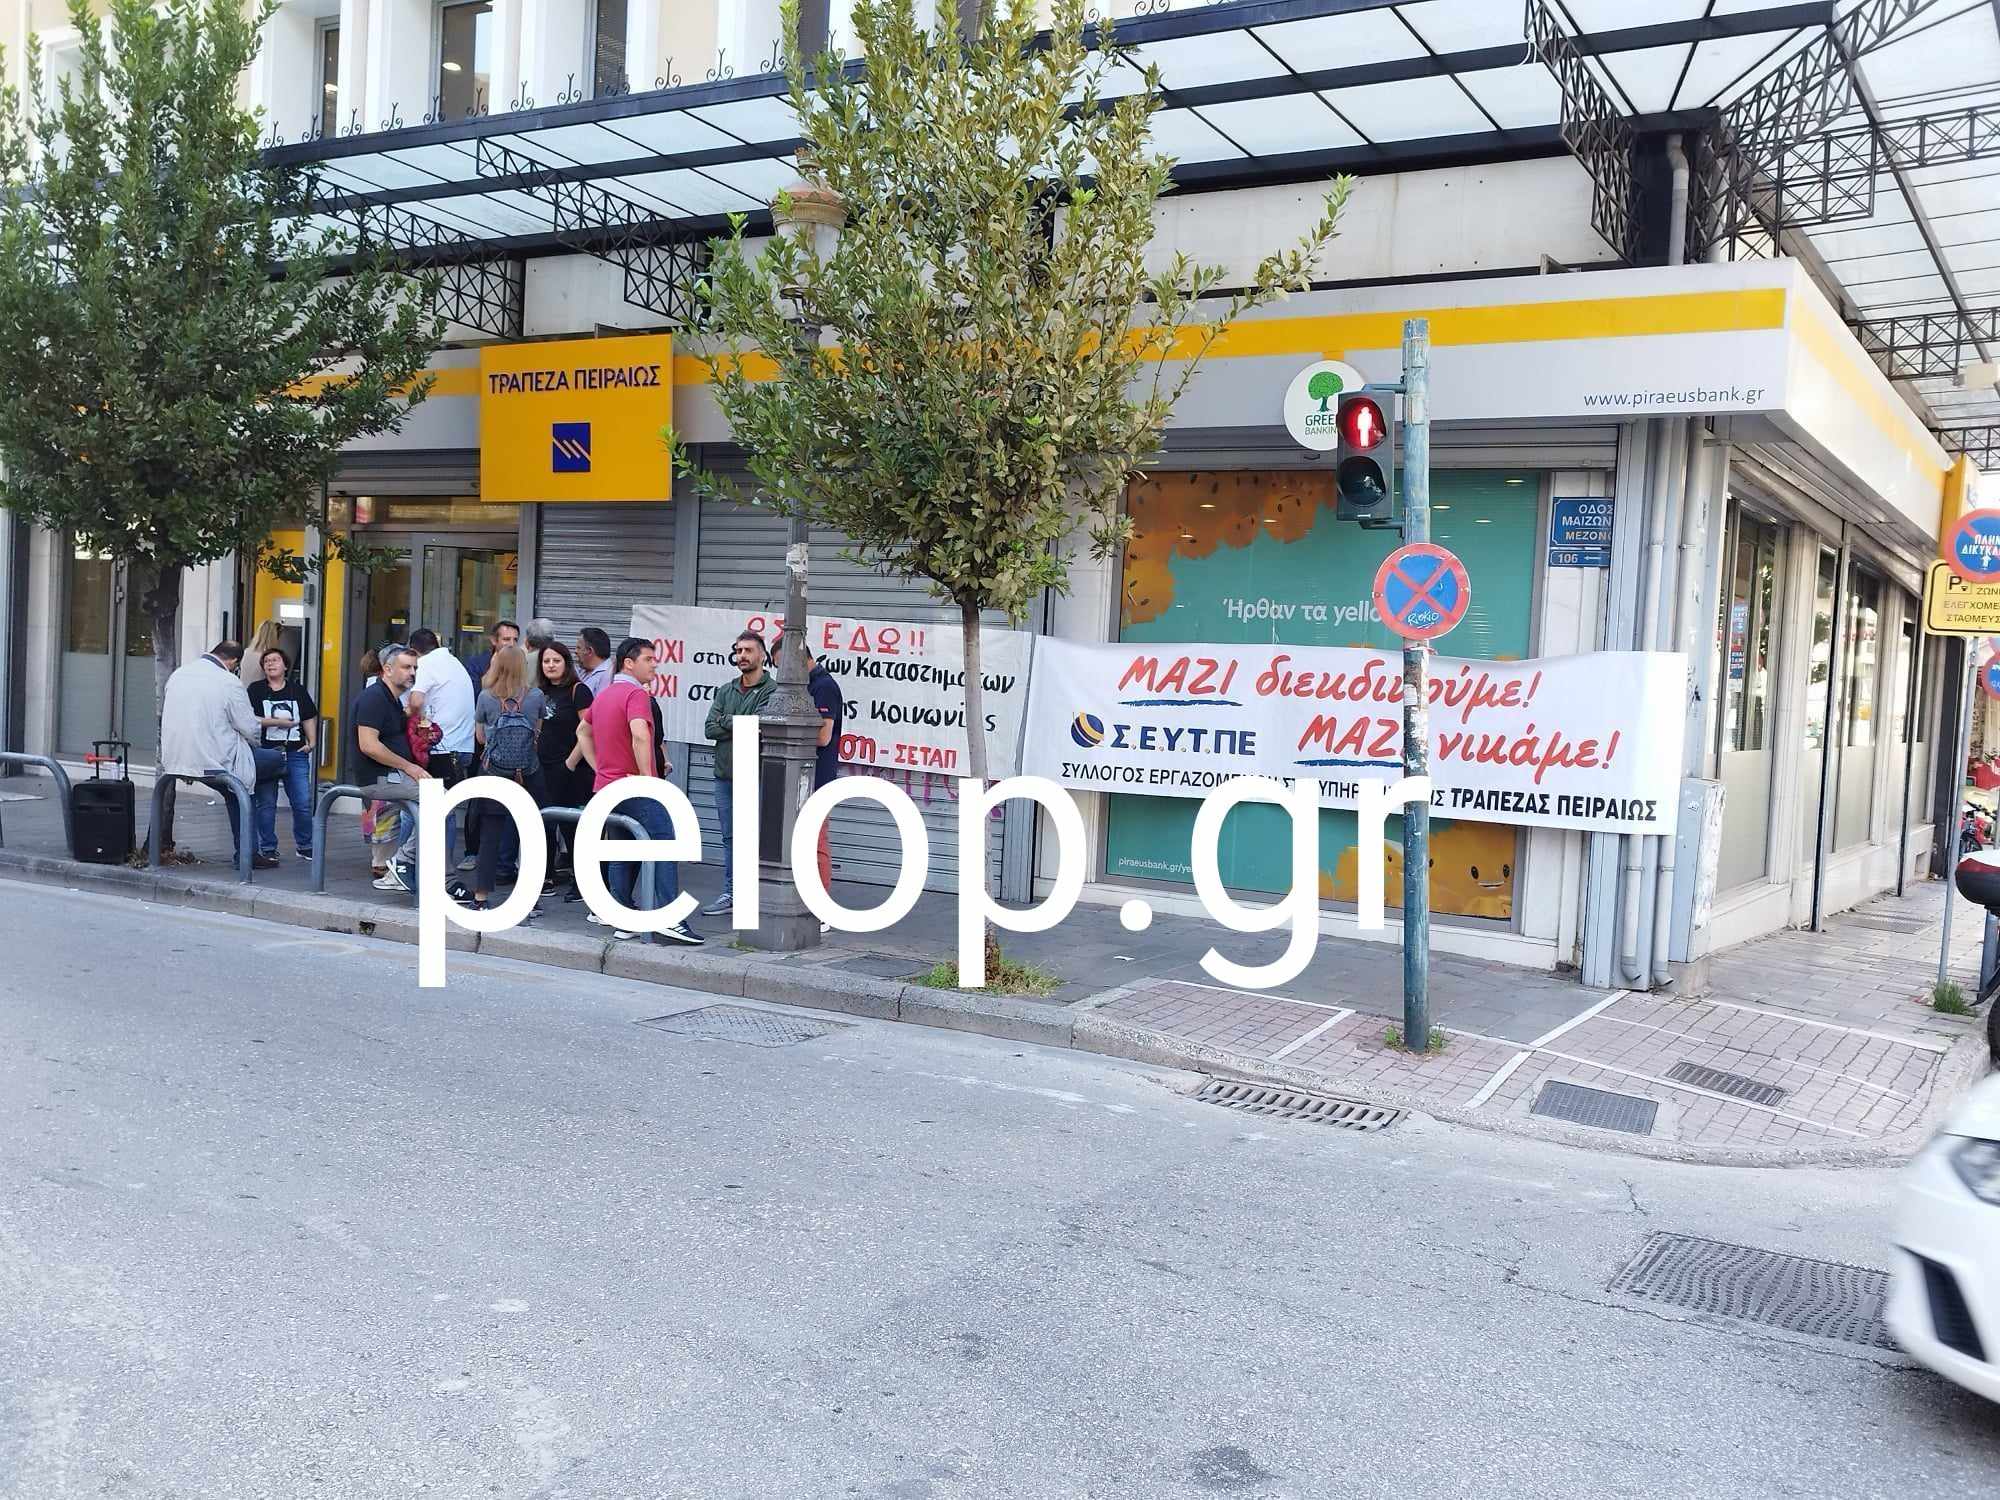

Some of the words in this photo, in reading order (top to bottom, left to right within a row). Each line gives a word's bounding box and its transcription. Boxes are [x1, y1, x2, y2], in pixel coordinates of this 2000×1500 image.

[489, 371, 570, 394] ΤΡΑΠΕΖΑ
[574, 365, 661, 390] ΠΕΙΡΑΙΩΣ
[1584, 386, 1766, 408] www.piraeusbank.gr
[1304, 427, 1337, 436] BANKIN
[1305, 414, 1335, 426] GREE
[1578, 504, 1613, 514] ΟΔΟΣ
[1562, 516, 1612, 527] ΜΑΙΖΩΝ
[1565, 531, 1612, 541] MEZON
[1223, 598, 1296, 624] Ήρθαν
[1301, 604, 1328, 621] τα
[1333, 600, 1382, 626] yello
[1944, 600, 2000, 610] ΕΛΕΓΧΟΜΕ
[823, 622, 926, 657] ΕΔΩ!!
[693, 651, 726, 666] στη
[1118, 655, 1238, 696] ΜΑΖΙ
[870, 700, 997, 732] Κοινωνίς
[894, 744, 958, 769] ΣΕΤΑΠ
[1297, 714, 1405, 759] ΜΑΖ
[1438, 723, 1622, 785] νικάμε!
[1061, 763, 1146, 784] ΣΥΛΛΟΓΟΣ
[1451, 787, 1550, 815] ΤΡΑΠΕΖΑΣ
[1557, 795, 1657, 821] ΠΕΙΡΑΙΩΣ
